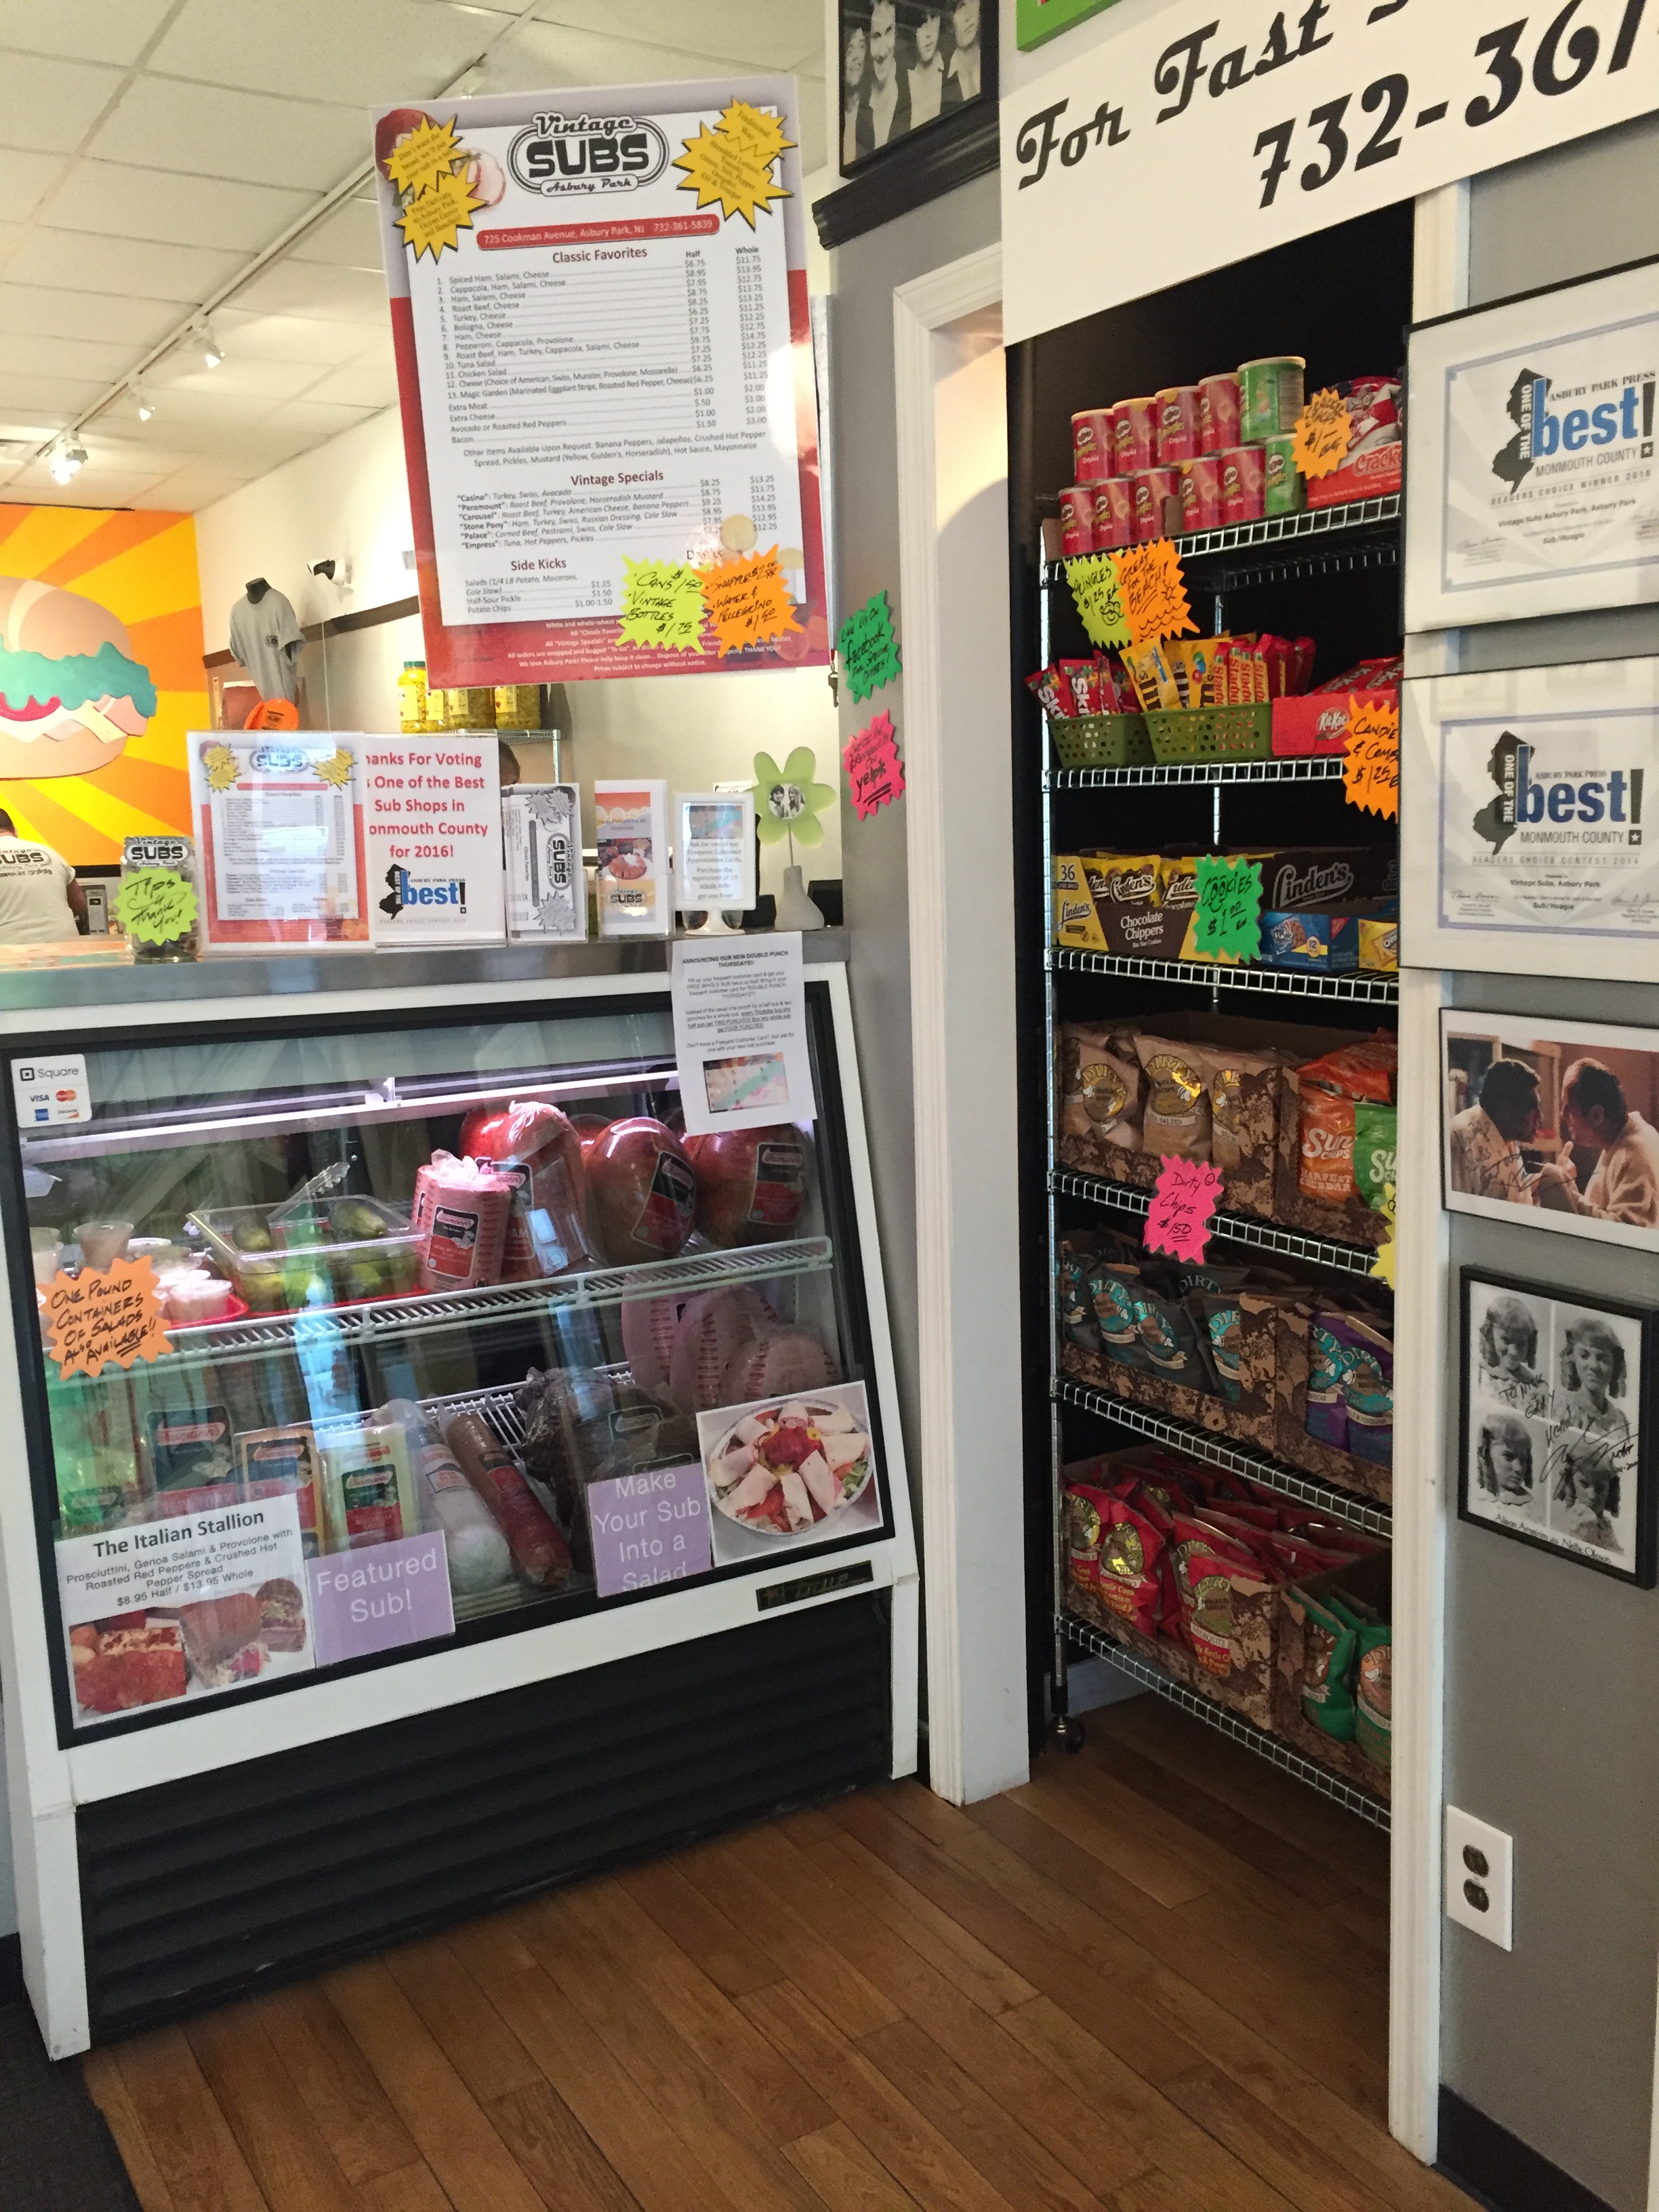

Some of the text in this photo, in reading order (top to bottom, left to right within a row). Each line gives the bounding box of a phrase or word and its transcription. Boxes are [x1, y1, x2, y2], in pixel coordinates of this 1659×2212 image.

[1016, 0, 1335, 190] For Fast
[535, 114, 635, 136] Vintage
[527, 134, 649, 178] SUBS
[546, 177, 633, 193] Asbury Park
[485, 219, 713, 244] 725 Cookman Avenue, Asbury Park, NJ 732-361-5839
[553, 247, 648, 264] Classic Favorites
[449, 276, 473, 285] Spiced
[475, 275, 494, 283] Ham,
[495, 272, 521, 282] Salami,
[523, 270, 550, 279] Cheese
[1549, 370, 1656, 402] ASBURY PARK PRESS
[1521, 384, 1532, 413] ONE
[1520, 415, 1532, 432] OF
[1533, 377, 1656, 458] best!
[1519, 435, 1532, 460] THE
[1536, 447, 1637, 477] MONMOUTH COUNTY
[571, 470, 663, 487] Vintage Specials
[511, 558, 567, 571] Side Kicks
[1120, 552, 1149, 586] GREAT
[637, 571, 673, 590] CANS
[711, 575, 750, 594] SNAPPLE
[630, 590, 676, 608] VINTAGE
[717, 592, 747, 609] WATER
[718, 599, 773, 623] PELLEGRINO
[626, 609, 674, 621] BOTTLES
[1319, 712, 1347, 731] KitKat
[409, 752, 482, 768] For Voting
[1504, 754, 1515, 779] ONE
[375, 776, 485, 789] One of the Best
[1504, 781, 1515, 798] OF
[375, 799, 465, 814] Sub Shops in
[1517, 745, 1644, 845] best!
[1502, 800, 1513, 822] THE
[136, 837, 176, 847] Vintage
[438, 823, 488, 837] County
[1521, 831, 1624, 844] MONMOUTH COUNTY
[131, 846, 183, 860] SUBS
[390, 845, 454, 857] for 2016!
[553, 840, 567, 884] SUBS
[1061, 864, 1076, 881] 36
[400, 869, 466, 914] best!
[1110, 874, 1157, 903] Linden's
[1202, 872, 1252, 907] COOKIES
[1272, 862, 1354, 908] Linden's
[610, 894, 642, 903] SUBS
[1058, 900, 1091, 932] Linden's
[1120, 912, 1164, 929] Chocolate
[1125, 925, 1164, 942] Chippers
[1309, 936, 1317, 949] 12
[38, 1068, 79, 1079] Square
[1145, 1054, 1198, 1084] DIRTY
[1302, 1127, 1353, 1158] Sun
[1322, 1149, 1350, 1160] CHIPS
[1171, 1172, 1201, 1197] Dirty
[1299, 1178, 1352, 1192] CHEDDAR
[1300, 1168, 1352, 1184] HARVEST
[1160, 1192, 1196, 1218] Chips
[51, 1279, 131, 1309] ONE POUND
[56, 1292, 144, 1330] CONTAINERS
[64, 1309, 142, 1346] OF SALADS
[64, 1340, 91, 1366] ALSO
[615, 1471, 677, 1499] Make
[595, 1496, 702, 1536] Your Sub
[93, 1511, 264, 1557] The Italian Stallion
[134, 1555, 169, 1570] Genoa
[171, 1549, 206, 1561] Salami
[209, 1544, 216, 1553] &
[220, 1534, 270, 1551] Provolone
[272, 1528, 293, 1540] with
[619, 1534, 687, 1563] Into a
[85, 1542, 278, 1591] Roasted Red Peppers & Crushed Hot
[146, 1565, 224, 1589] Pepper Spread
[316, 1548, 437, 1596] Featured
[117, 1592, 148, 1607] $8.95
[151, 1586, 172, 1599] Half
[222, 1569, 253, 1582] Whole
[350, 1588, 412, 1622] Sub!
